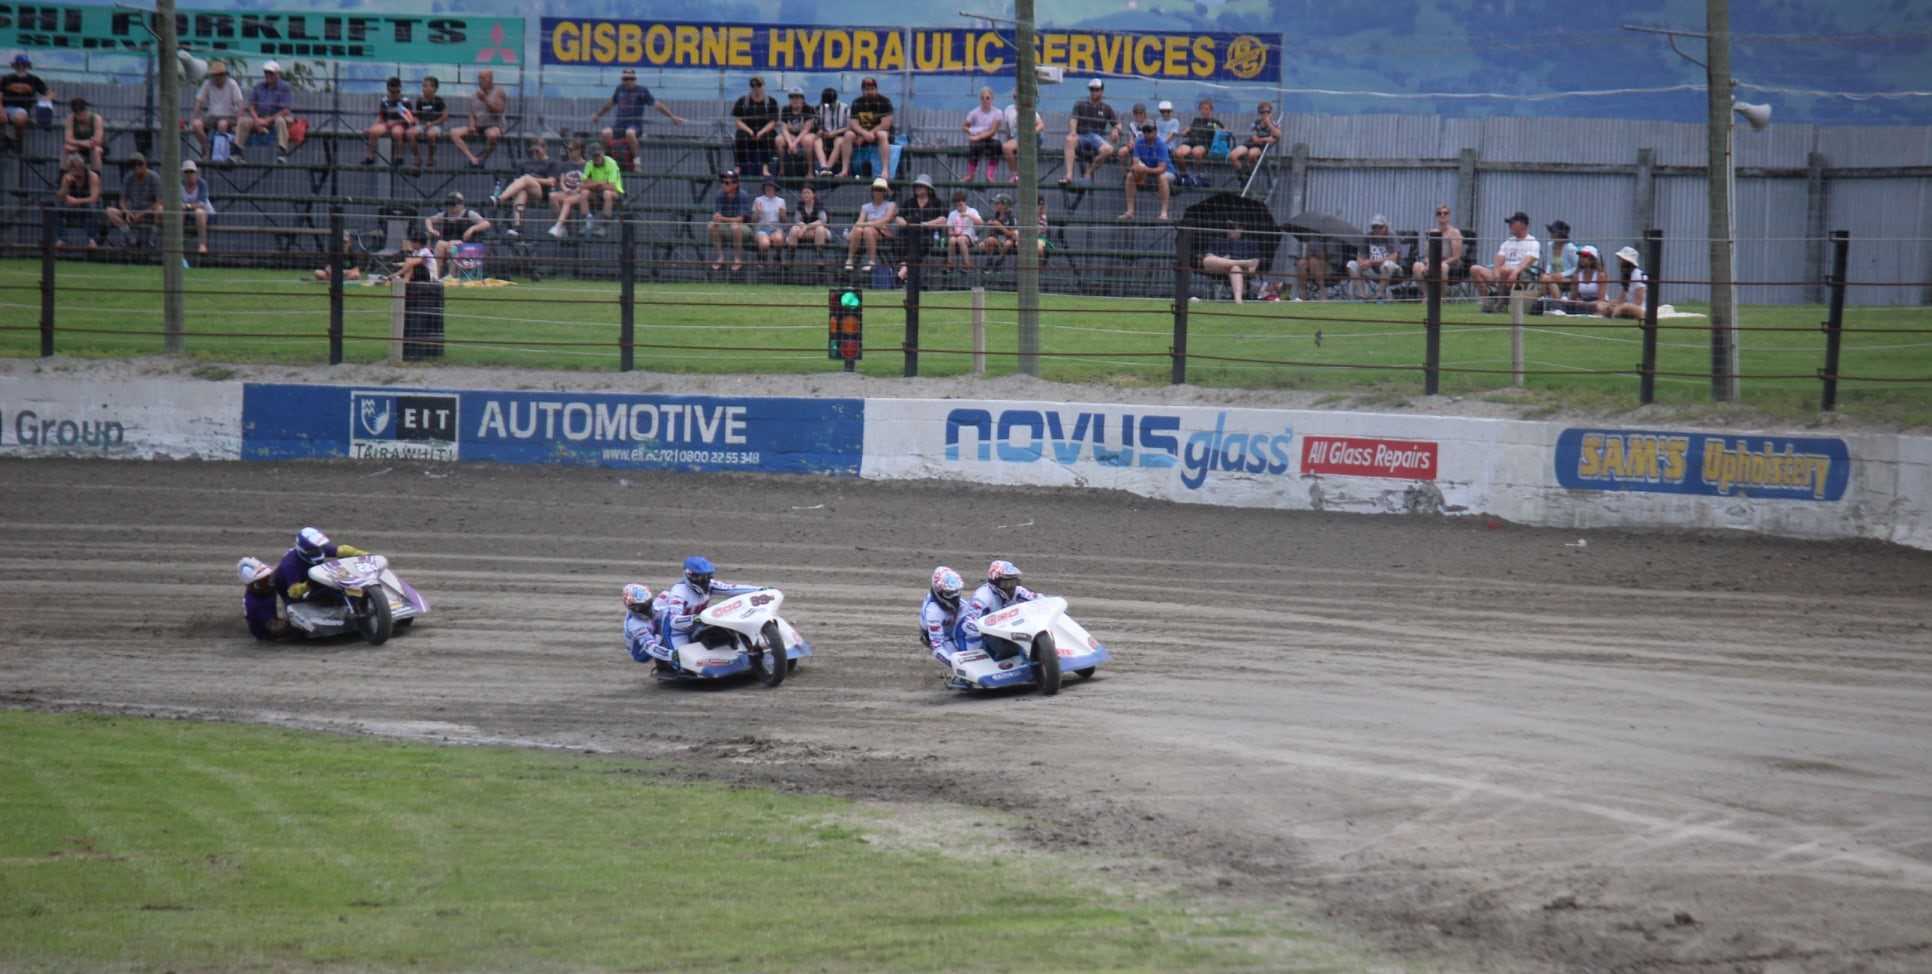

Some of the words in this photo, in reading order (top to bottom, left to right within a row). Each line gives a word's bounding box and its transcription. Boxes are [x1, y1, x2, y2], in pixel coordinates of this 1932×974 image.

[17, 34, 240, 51] SERVCE
[112, 13, 467, 44] FORKLIFTS
[552, 22, 753, 67] GISBORNE
[768, 28, 1004, 74] HYDRAULIC
[16, 410, 124, 452] Group
[405, 408, 450, 430] EIT
[478, 400, 747, 444] AUTOMOTIVE
[1308, 441, 1328, 464] All
[1329, 442, 1373, 466] Glass
[1374, 444, 1431, 473] Repairs
[1578, 434, 1688, 484] SAM'S
